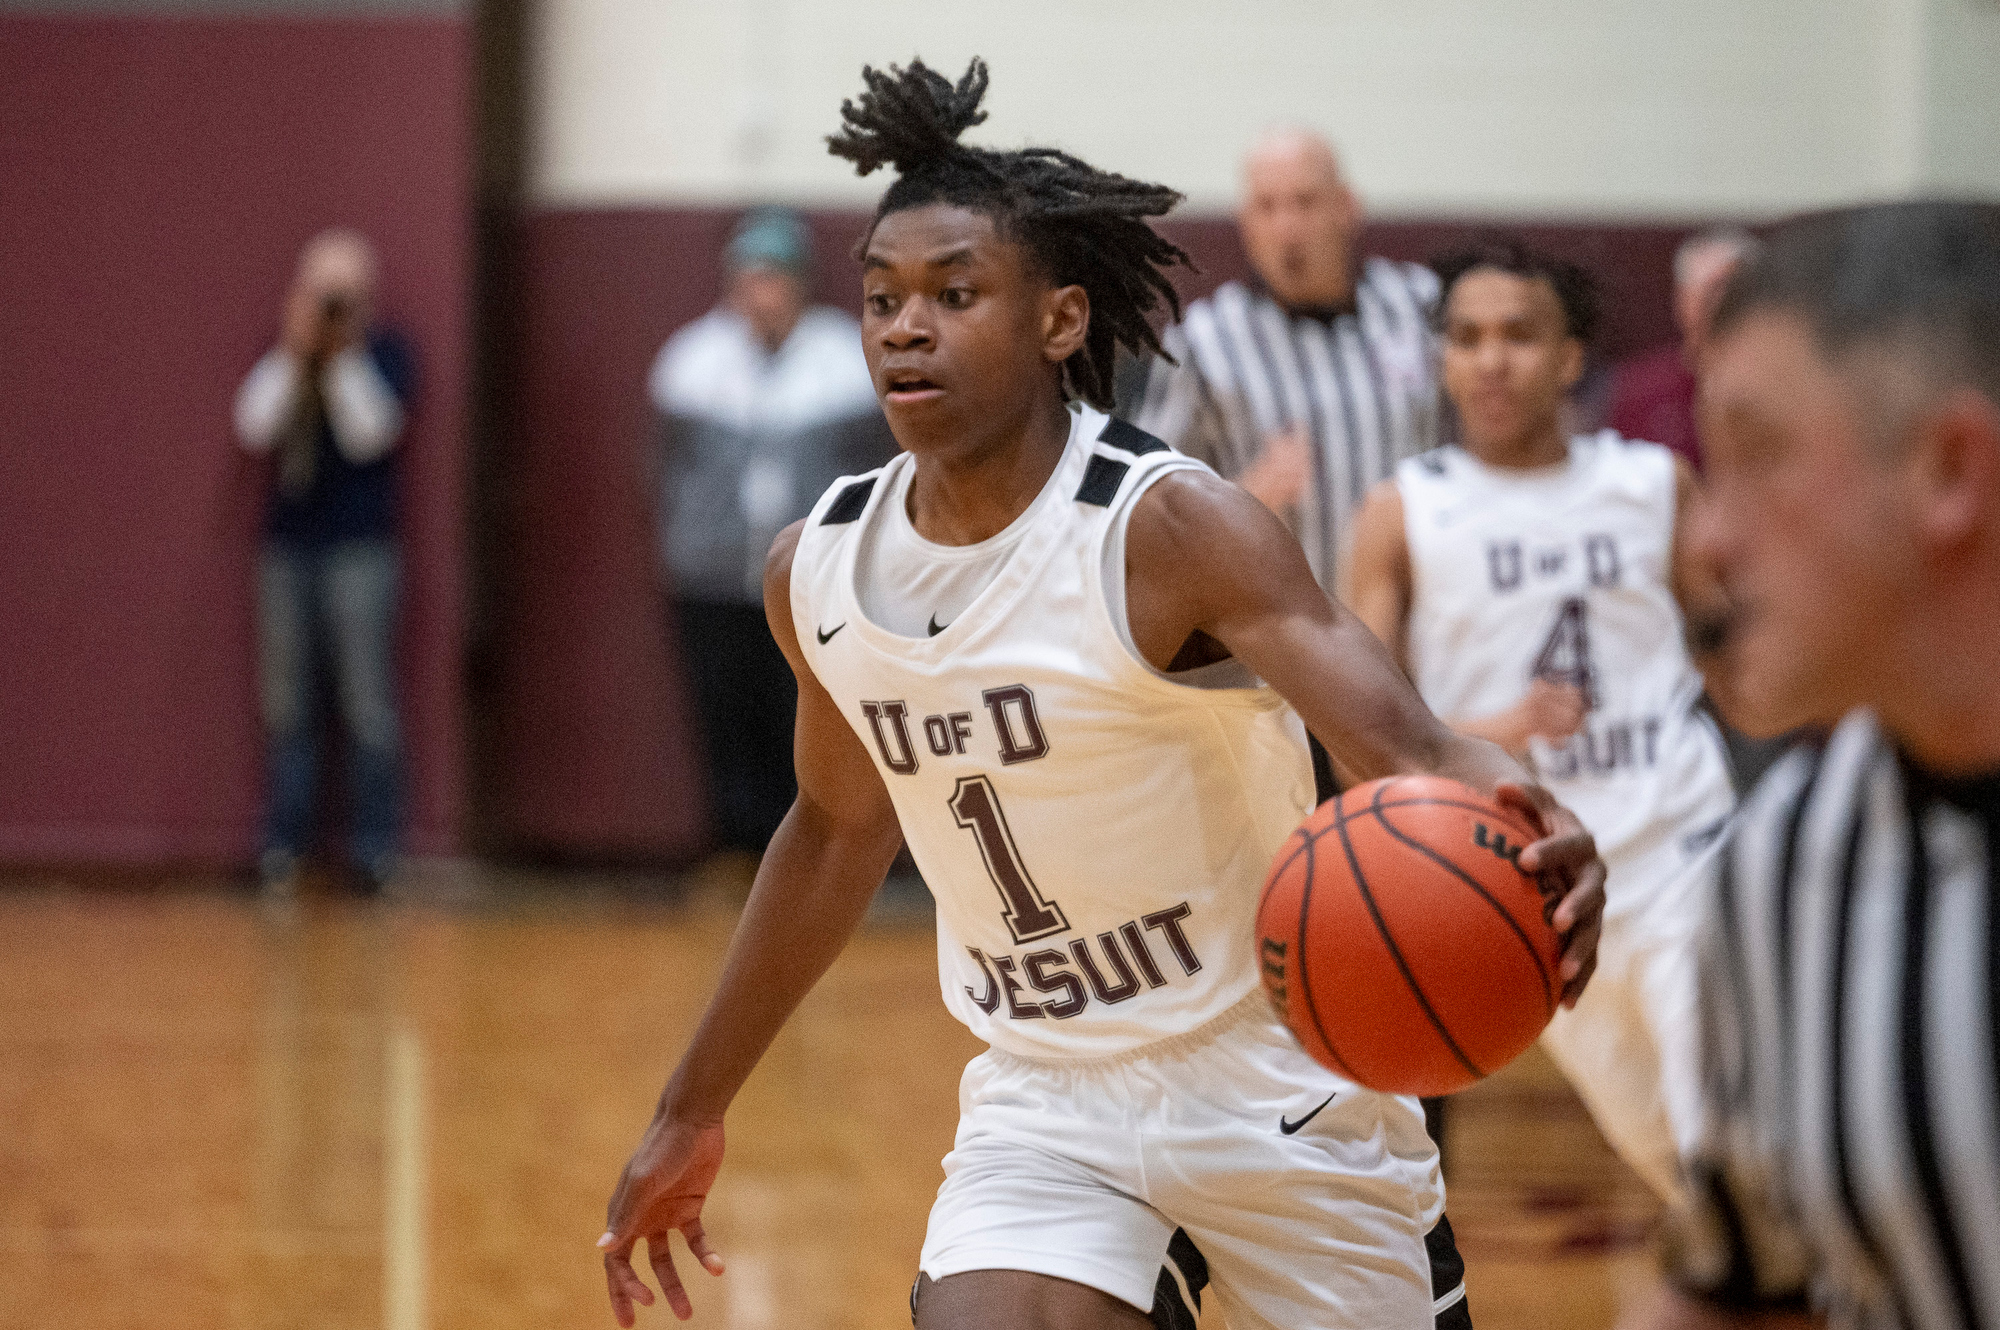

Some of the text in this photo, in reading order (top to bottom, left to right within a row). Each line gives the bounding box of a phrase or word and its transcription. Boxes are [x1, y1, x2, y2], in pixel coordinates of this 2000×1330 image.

[1487, 539, 1523, 594] U
[1584, 533, 1622, 590] D
[1529, 596, 1602, 713] 4
[860, 683, 1050, 775] U OF D
[947, 774, 1071, 946] 1
[964, 901, 1203, 1020] JESUIT
